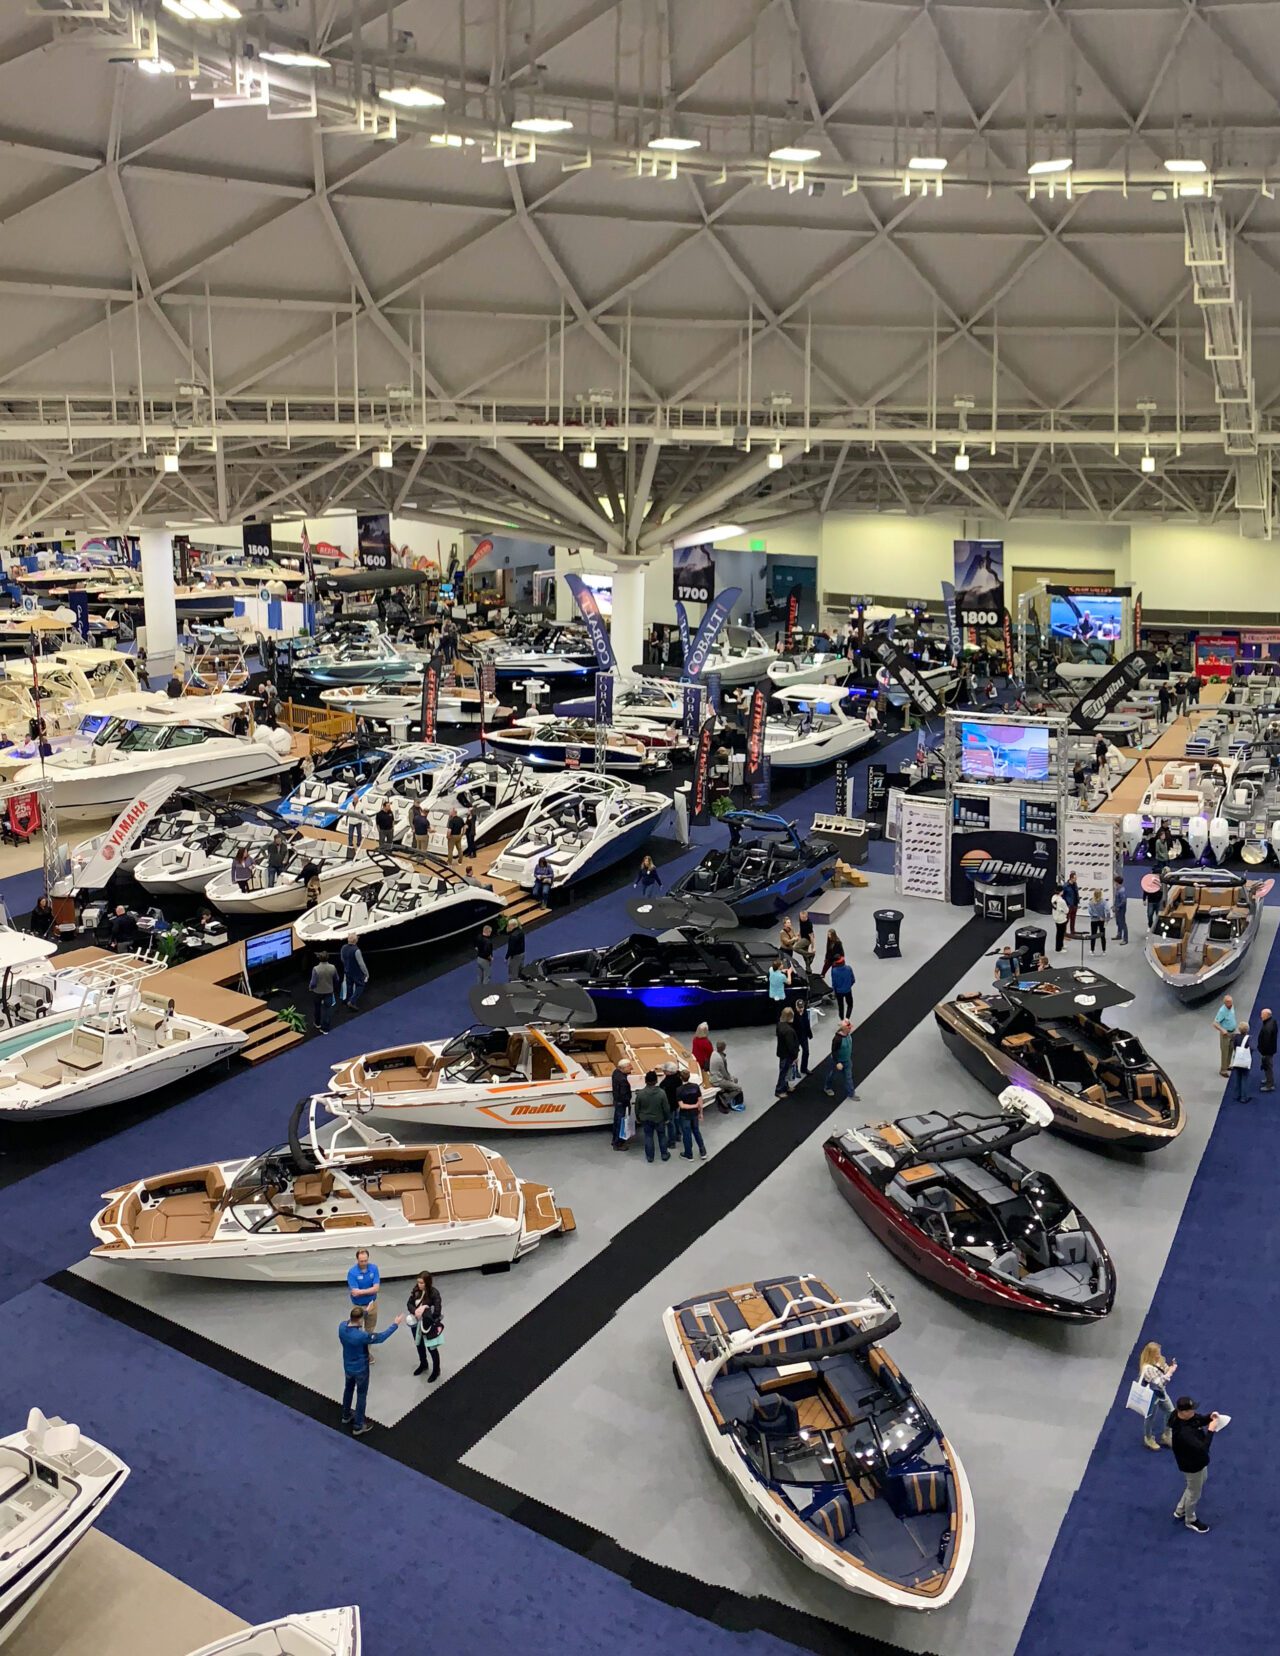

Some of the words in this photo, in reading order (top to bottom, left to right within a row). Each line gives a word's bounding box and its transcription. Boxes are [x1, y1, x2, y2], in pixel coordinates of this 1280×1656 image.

[248, 544, 270, 556] 1500
[363, 554, 386, 566] 1600
[678, 586, 708, 600] 1700
[961, 611, 998, 625] 1800
[688, 608, 724, 675] COBALT
[110, 800, 149, 846] YAMAHA
[978, 860, 1047, 879] Malibu
[510, 1102, 566, 1116] Malibu
